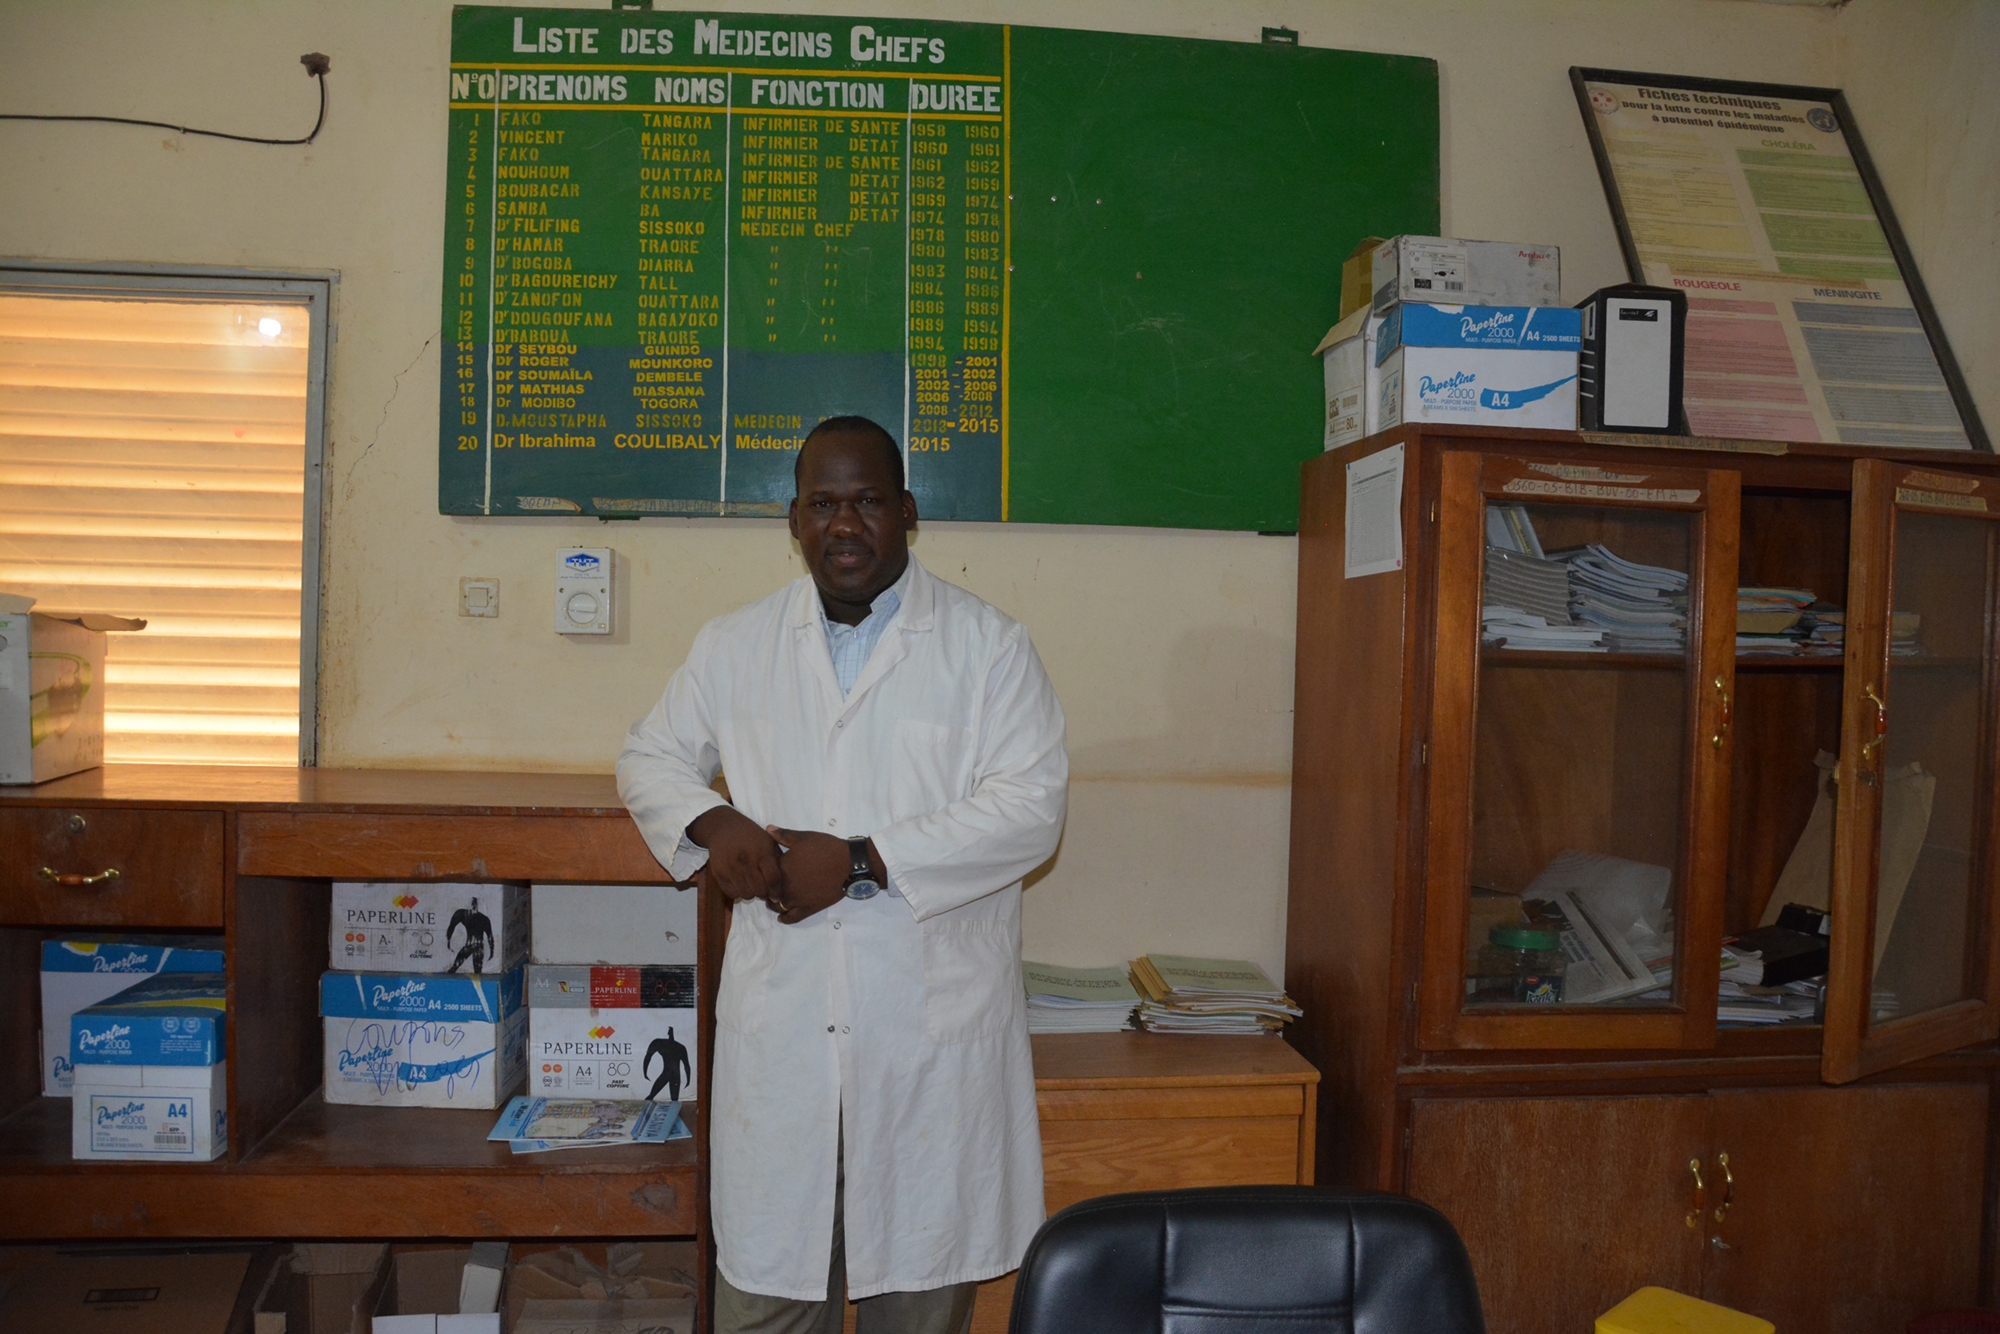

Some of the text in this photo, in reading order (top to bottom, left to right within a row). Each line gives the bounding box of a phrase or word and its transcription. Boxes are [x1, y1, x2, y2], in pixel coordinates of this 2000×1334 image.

[513, 17, 945, 64] LISTE DES MEDECINS CHEFS
[501, 74, 1000, 112] PRENOMS NOMS FONCTION DUREE
[1638, 88, 1781, 112] Fiches techniques
[1622, 101, 1805, 124] pour la lutte contre les maladies
[501, 112, 999, 139] FAKO TANGARA INFIRMIER SANTE 1958 1960
[1652, 114, 1785, 134] à potentiel épidémique
[500, 130, 999, 157] VINCENT MARIKO INFIRMIER 1960 1961
[498, 147, 999, 174] FAKO TANGARA INFIRMIER SANTE 1961 1962
[498, 165, 999, 191] NOUHOUM OUATTARA INFIRMIER 1962 1969
[498, 184, 998, 210] BOUBACAR KANSAYE INFIRMIER 1969 1974
[497, 202, 999, 226] SAMBA BA INFIRMIER 1974 1978
[639, 221, 705, 235] SISSOKO
[740, 223, 805, 236] MEDECIN
[814, 223, 855, 237] CHEF
[911, 228, 945, 241] 1978
[965, 229, 999, 243] 1980
[639, 239, 699, 254] TRAORE
[911, 244, 945, 257] 1980
[965, 247, 999, 261] 1983
[639, 258, 694, 272] DIARRA
[911, 264, 945, 277] 1983
[965, 265, 998, 281] 1984
[639, 275, 678, 290] TALL
[911, 282, 943, 296] 1984
[1673, 278, 1742, 291] ROUGEOLE
[1813, 287, 1882, 301] MÉNINGITE
[638, 294, 719, 309] OUATTARA
[910, 301, 944, 315] 1986
[965, 301, 998, 316] 1989
[638, 313, 718, 327] BAGAYOKO
[910, 318, 944, 332] 1989
[964, 320, 998, 335] 1994
[1460, 312, 1514, 338] Paperline
[1488, 328, 1514, 337] 2000
[638, 330, 699, 345] TRAORE
[910, 336, 944, 351] 1994
[963, 337, 998, 350] 1998
[1527, 331, 1540, 341] A4
[1559, 335, 1580, 343] SHEETS
[519, 344, 997, 367] SEYBOU GUINDO 2001
[520, 356, 996, 379] ROGER MOUNKORO 2001 2002
[518, 368, 997, 392] SOUMAÏLA DEMBELE 2002 2006
[1419, 371, 1475, 398] Paperline
[520, 384, 949, 403] MATHIAS DIASSANA 2006
[1447, 388, 1474, 399] 2000
[1491, 392, 1510, 407] A4
[460, 397, 993, 418] 18 MODIBO TOGORA 2008 2012
[461, 411, 476, 425] 19
[512, 413, 607, 427] MOUSTAPHA
[636, 414, 702, 428] SISSOKO
[734, 414, 802, 429] MEDECIN
[458, 436, 478, 450] 20
[520, 433, 596, 448] Ibrahima
[614, 433, 721, 449] COULIBALY
[910, 437, 950, 452] 2015
[572, 558, 594, 567] TMT
[347, 910, 436, 925] PAPERLINE
[373, 980, 426, 1007] Paperline
[535, 978, 549, 988] A4
[654, 979, 680, 995] 80
[399, 996, 425, 1006] 2000
[428, 1000, 441, 1009] A4
[79, 1024, 130, 1050] Paperline
[104, 1039, 130, 1049] 2000
[544, 1042, 632, 1055] PAPERLINE
[575, 1062, 630, 1076] A4 80
[97, 1101, 145, 1125] Paperline
[121, 1115, 145, 1125] 2000
[168, 1103, 187, 1118] A4
